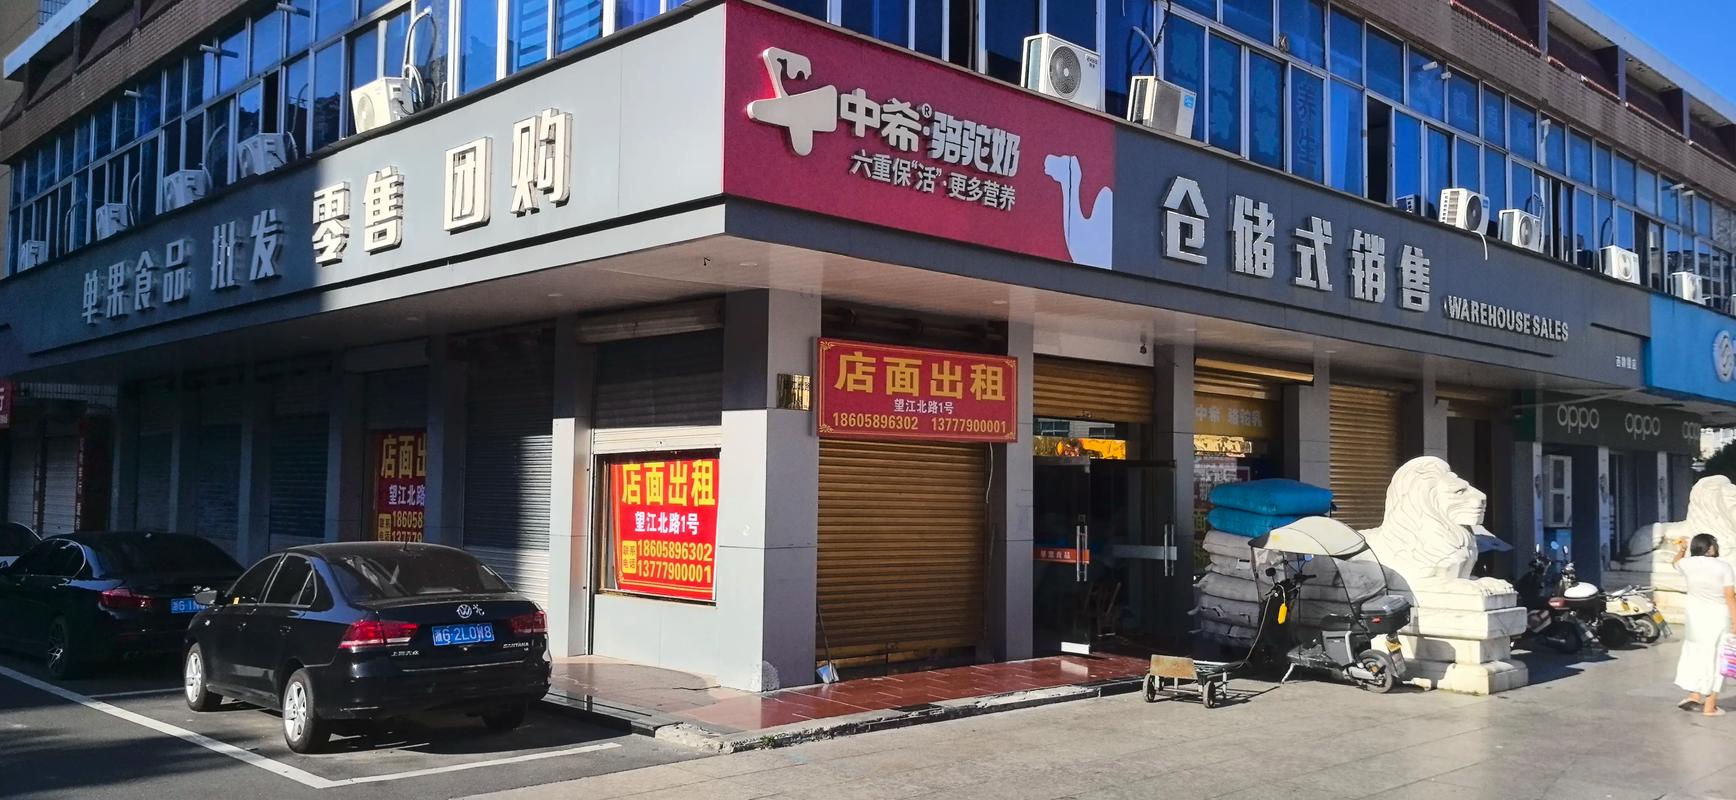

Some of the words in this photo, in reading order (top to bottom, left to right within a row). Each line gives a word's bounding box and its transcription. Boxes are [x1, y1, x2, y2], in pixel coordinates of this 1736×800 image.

[211, 208, 279, 291] 批发
[312, 165, 404, 267] 零售
[443, 107, 573, 234] 团购
[1161, 175, 1431, 313] 仓储式销售
[1447, 294, 1531, 335] WAREHOUSE
[1532, 314, 1569, 342] SALES
[833, 351, 1006, 401] 店面出租
[894, 398, 955, 415] 望江北路1号
[832, 412, 919, 431] 18605896302
[931, 417, 1006, 433] 13777900001
[388, 484, 426, 506] 望江北路
[621, 459, 716, 507] 店面出租
[634, 510, 700, 536] 望江北路1号
[637, 539, 713, 562] 18605896302
[637, 559, 712, 584] 13777900001
